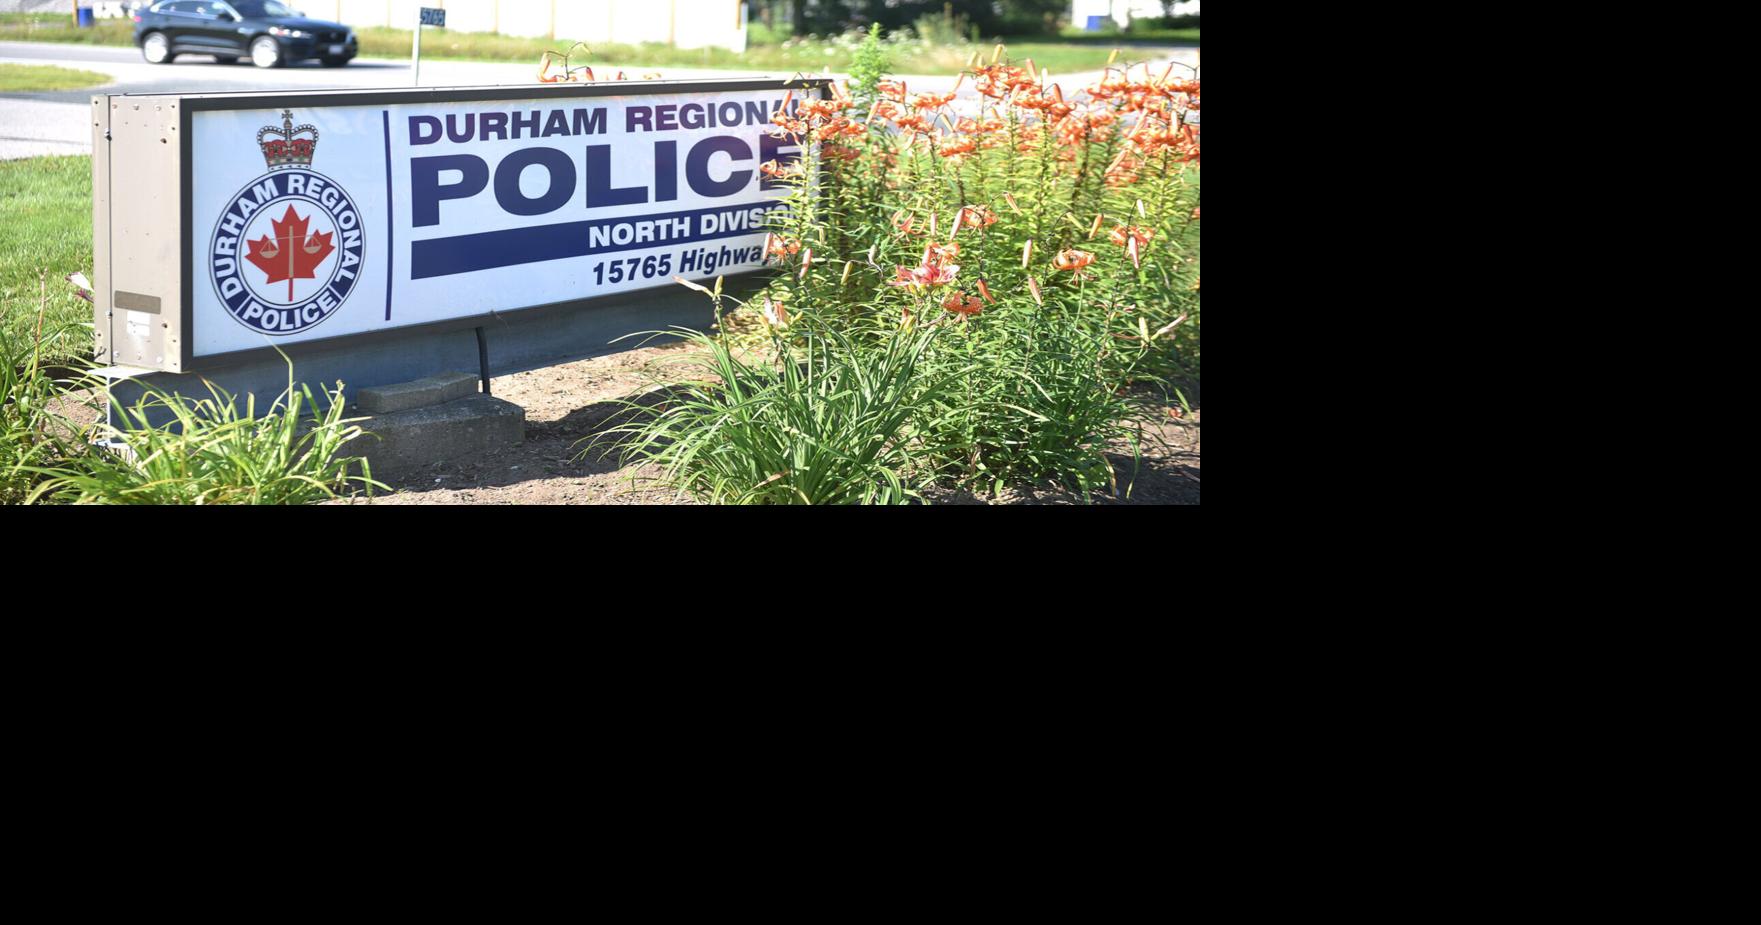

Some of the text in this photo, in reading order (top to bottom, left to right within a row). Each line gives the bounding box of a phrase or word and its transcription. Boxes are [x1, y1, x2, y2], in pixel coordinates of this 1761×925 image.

[408, 107, 607, 146] DURHAM
[410, 133, 804, 228] POLICE
[215, 174, 361, 300] DURHAM REGIONAL
[589, 216, 691, 249] NORTH
[593, 253, 672, 286] 15765
[242, 290, 337, 331] POLICE
